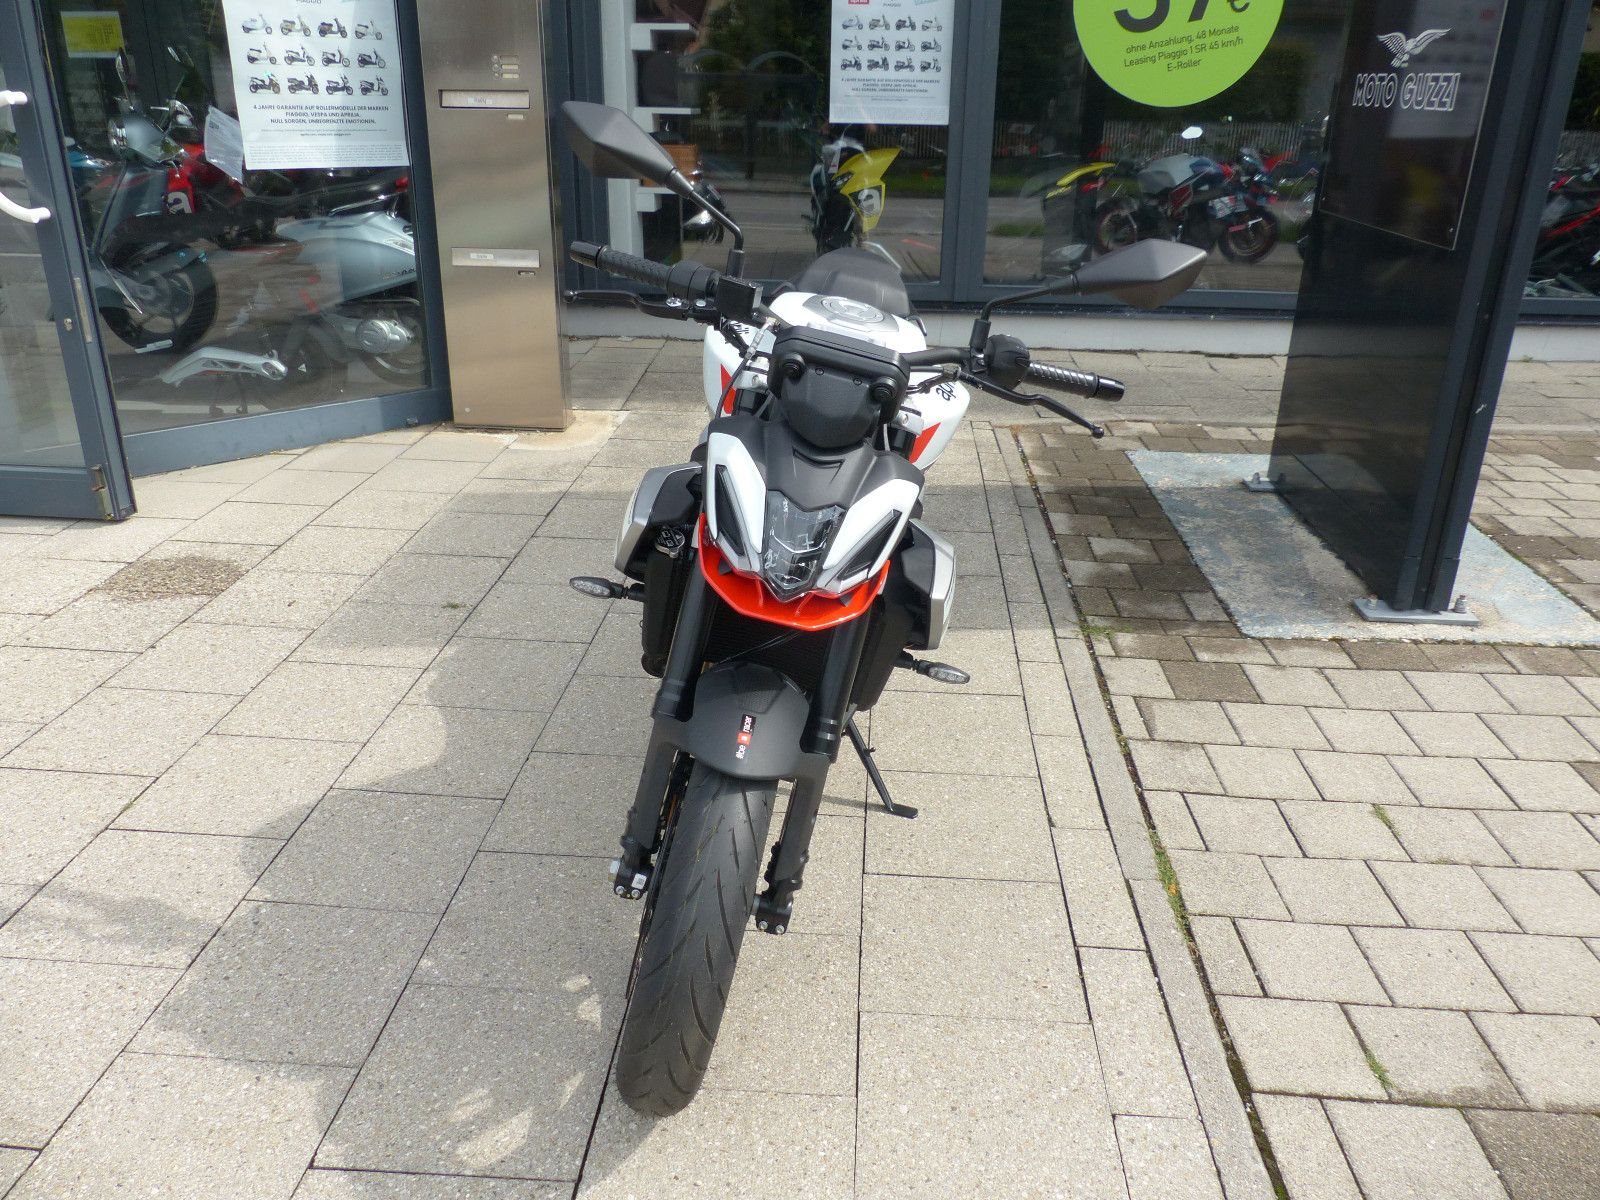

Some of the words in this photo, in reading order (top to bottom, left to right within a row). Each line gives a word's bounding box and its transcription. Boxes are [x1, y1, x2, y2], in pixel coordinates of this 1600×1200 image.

[1123, 55, 1157, 68] Leasing
[1158, 49, 1188, 62] Piaggio
[1194, 43, 1208, 54] SR
[1209, 41, 1219, 50] 45
[1221, 35, 1244, 49] km/h
[1126, 43, 1147, 54] ohne
[1149, 35, 1194, 49] Anzahlung,
[1196, 30, 1206, 39] 48
[1208, 25, 1240, 37] Monate
[1167, 59, 1201, 72] E-Roller
[1352, 73, 1398, 108] MOTO
[1400, 72, 1461, 112] GUZZI
[742, 715, 752, 733] racer
